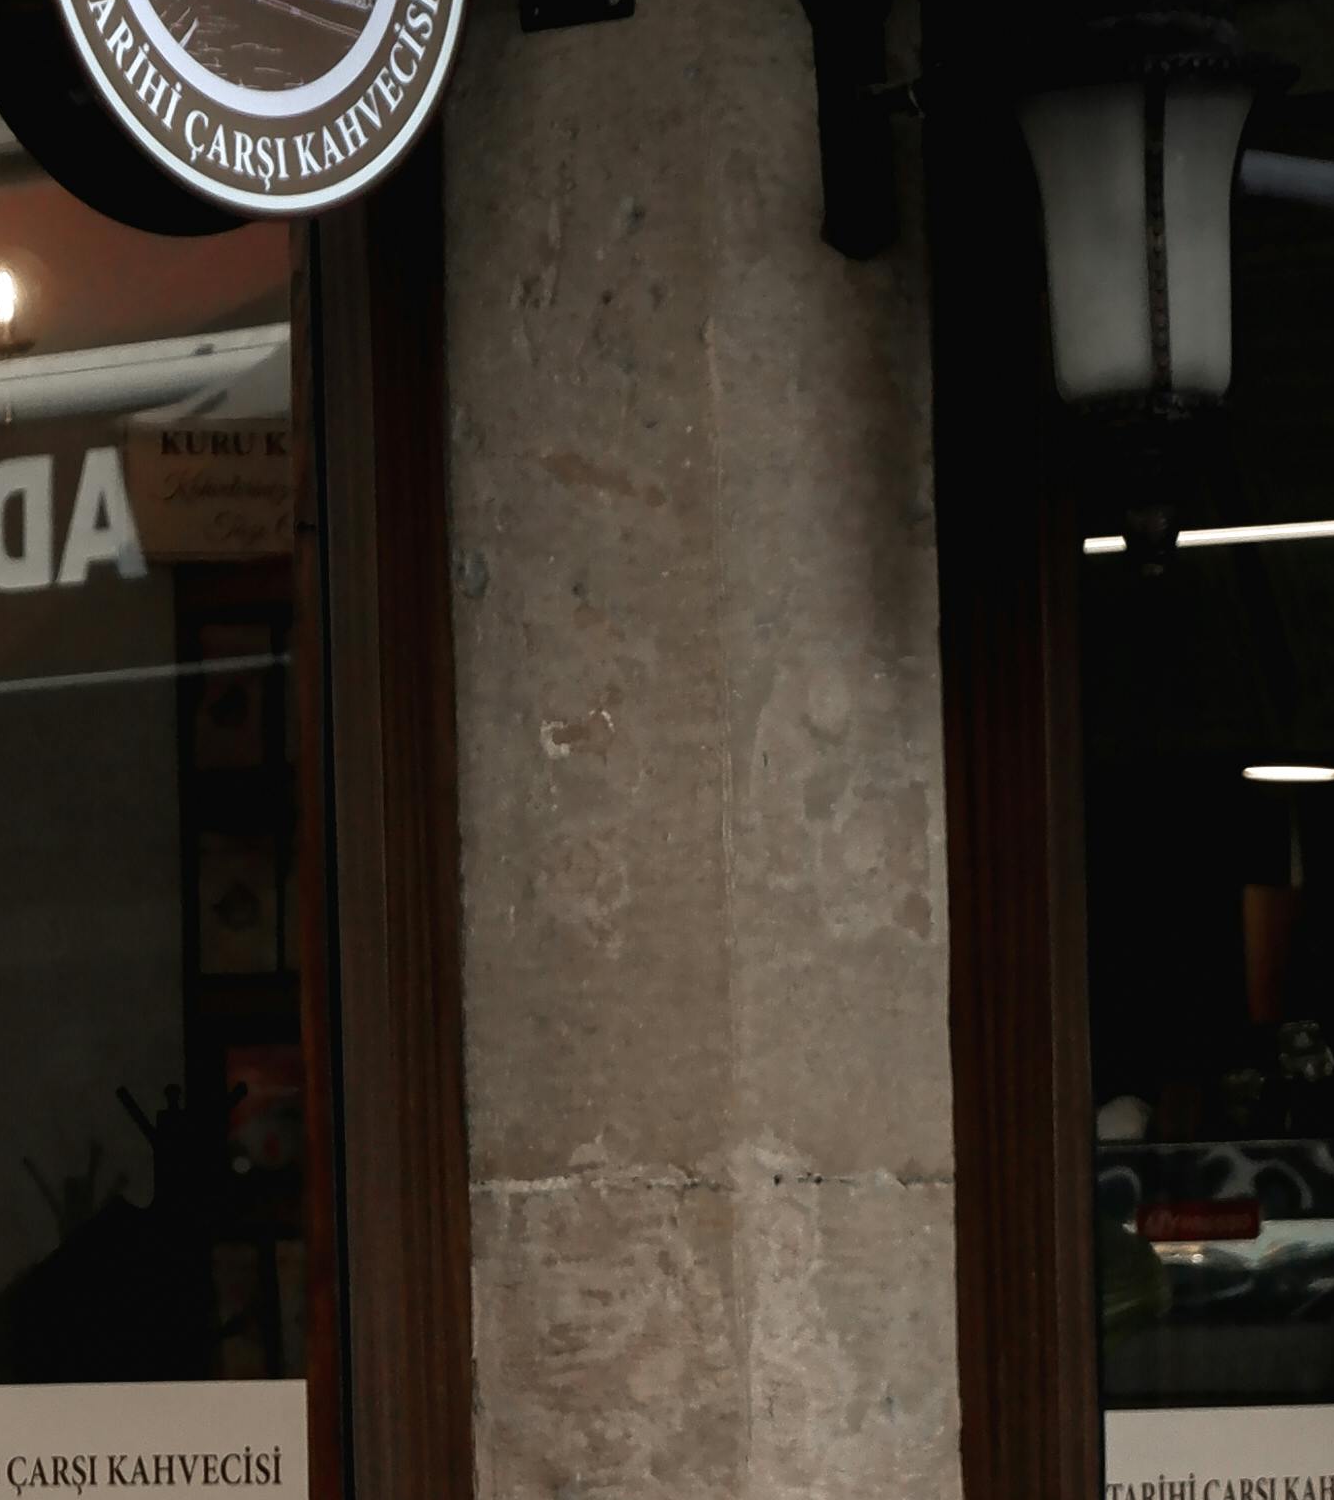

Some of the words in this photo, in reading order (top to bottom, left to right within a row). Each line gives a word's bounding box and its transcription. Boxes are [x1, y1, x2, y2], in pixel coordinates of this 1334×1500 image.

[184, 108, 294, 191] ÇARŞI
[5, 1453, 99, 1499] ÇARŞI
[103, 1444, 283, 1490] KAHVECİSİ
